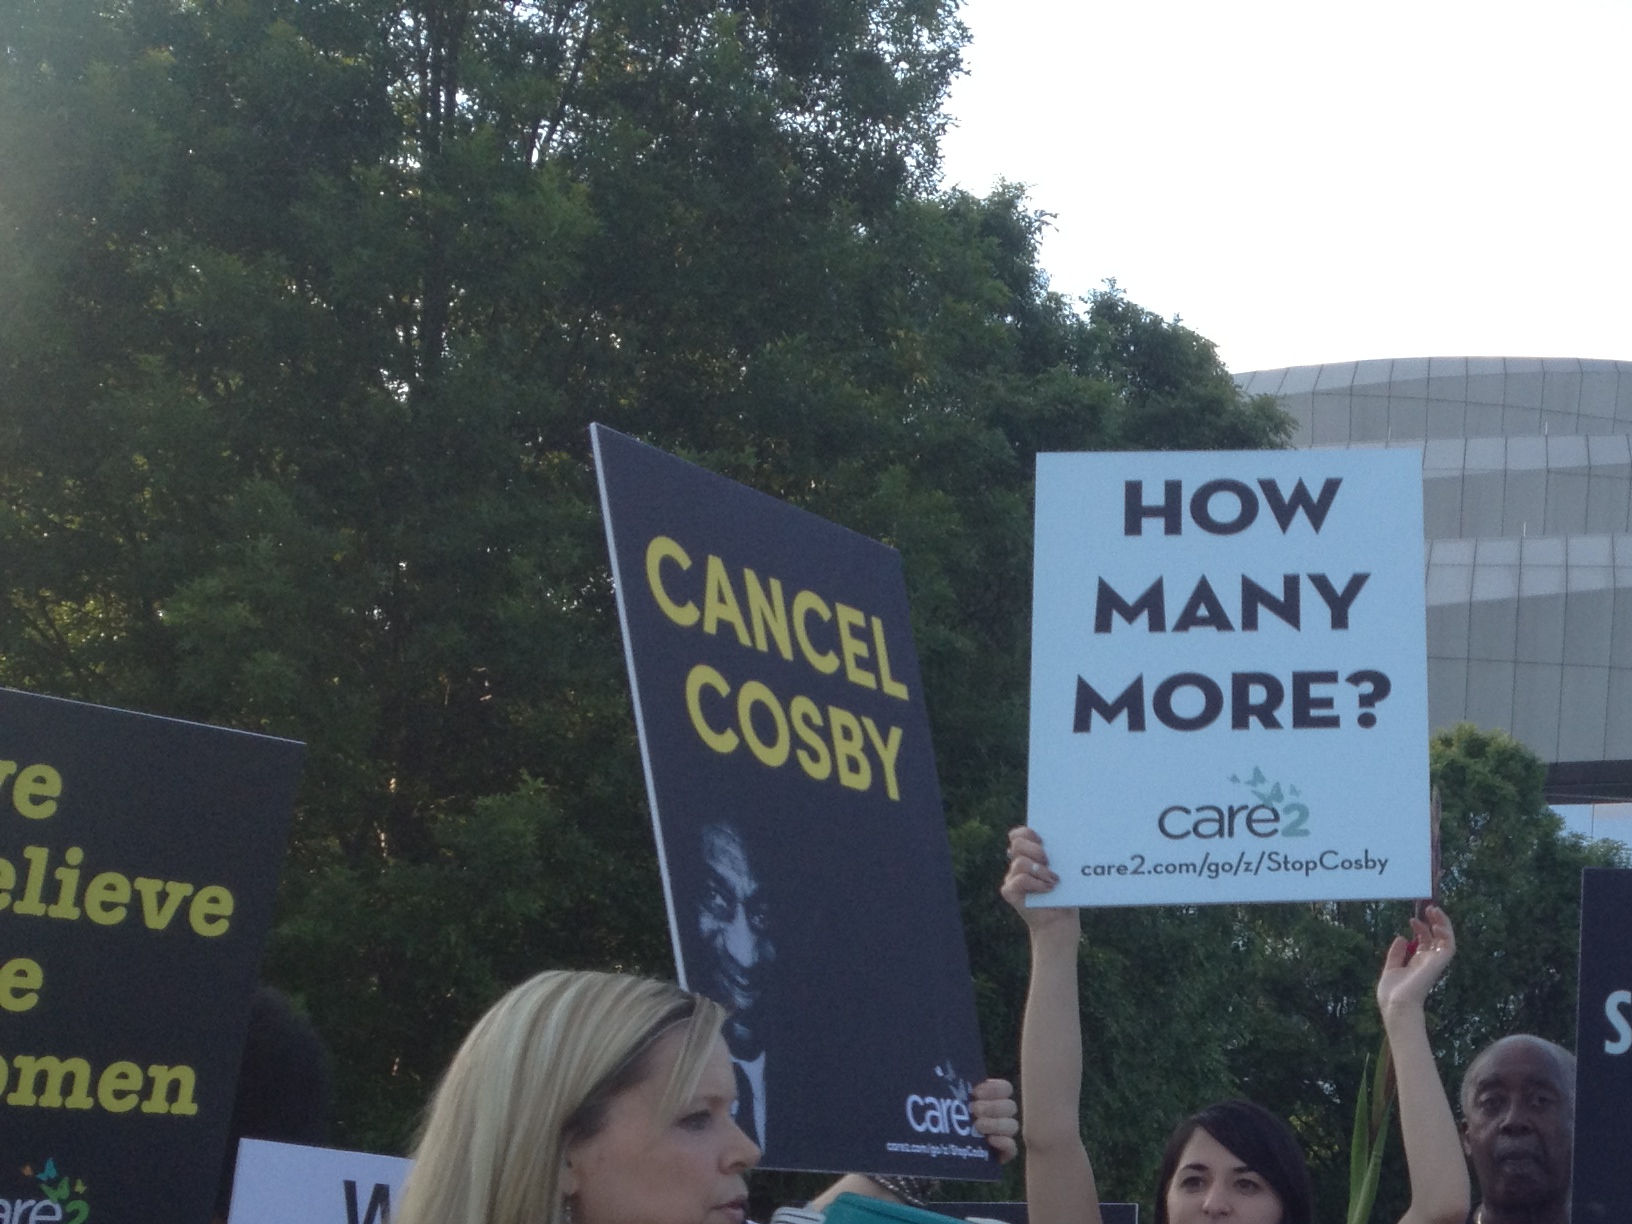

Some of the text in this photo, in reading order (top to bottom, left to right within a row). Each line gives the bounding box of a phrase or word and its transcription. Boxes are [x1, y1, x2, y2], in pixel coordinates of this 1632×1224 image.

[1124, 477, 1343, 536] HOW
[645, 536, 909, 701] CANCEL
[1094, 572, 1372, 634] MANY
[685, 663, 903, 801] COSBY
[1073, 669, 1392, 734] MORE?
[1158, 802, 1311, 841] care2
[1081, 849, 1390, 878] care2.com/go/z/StopCosby
[0, 1053, 198, 1116] men
